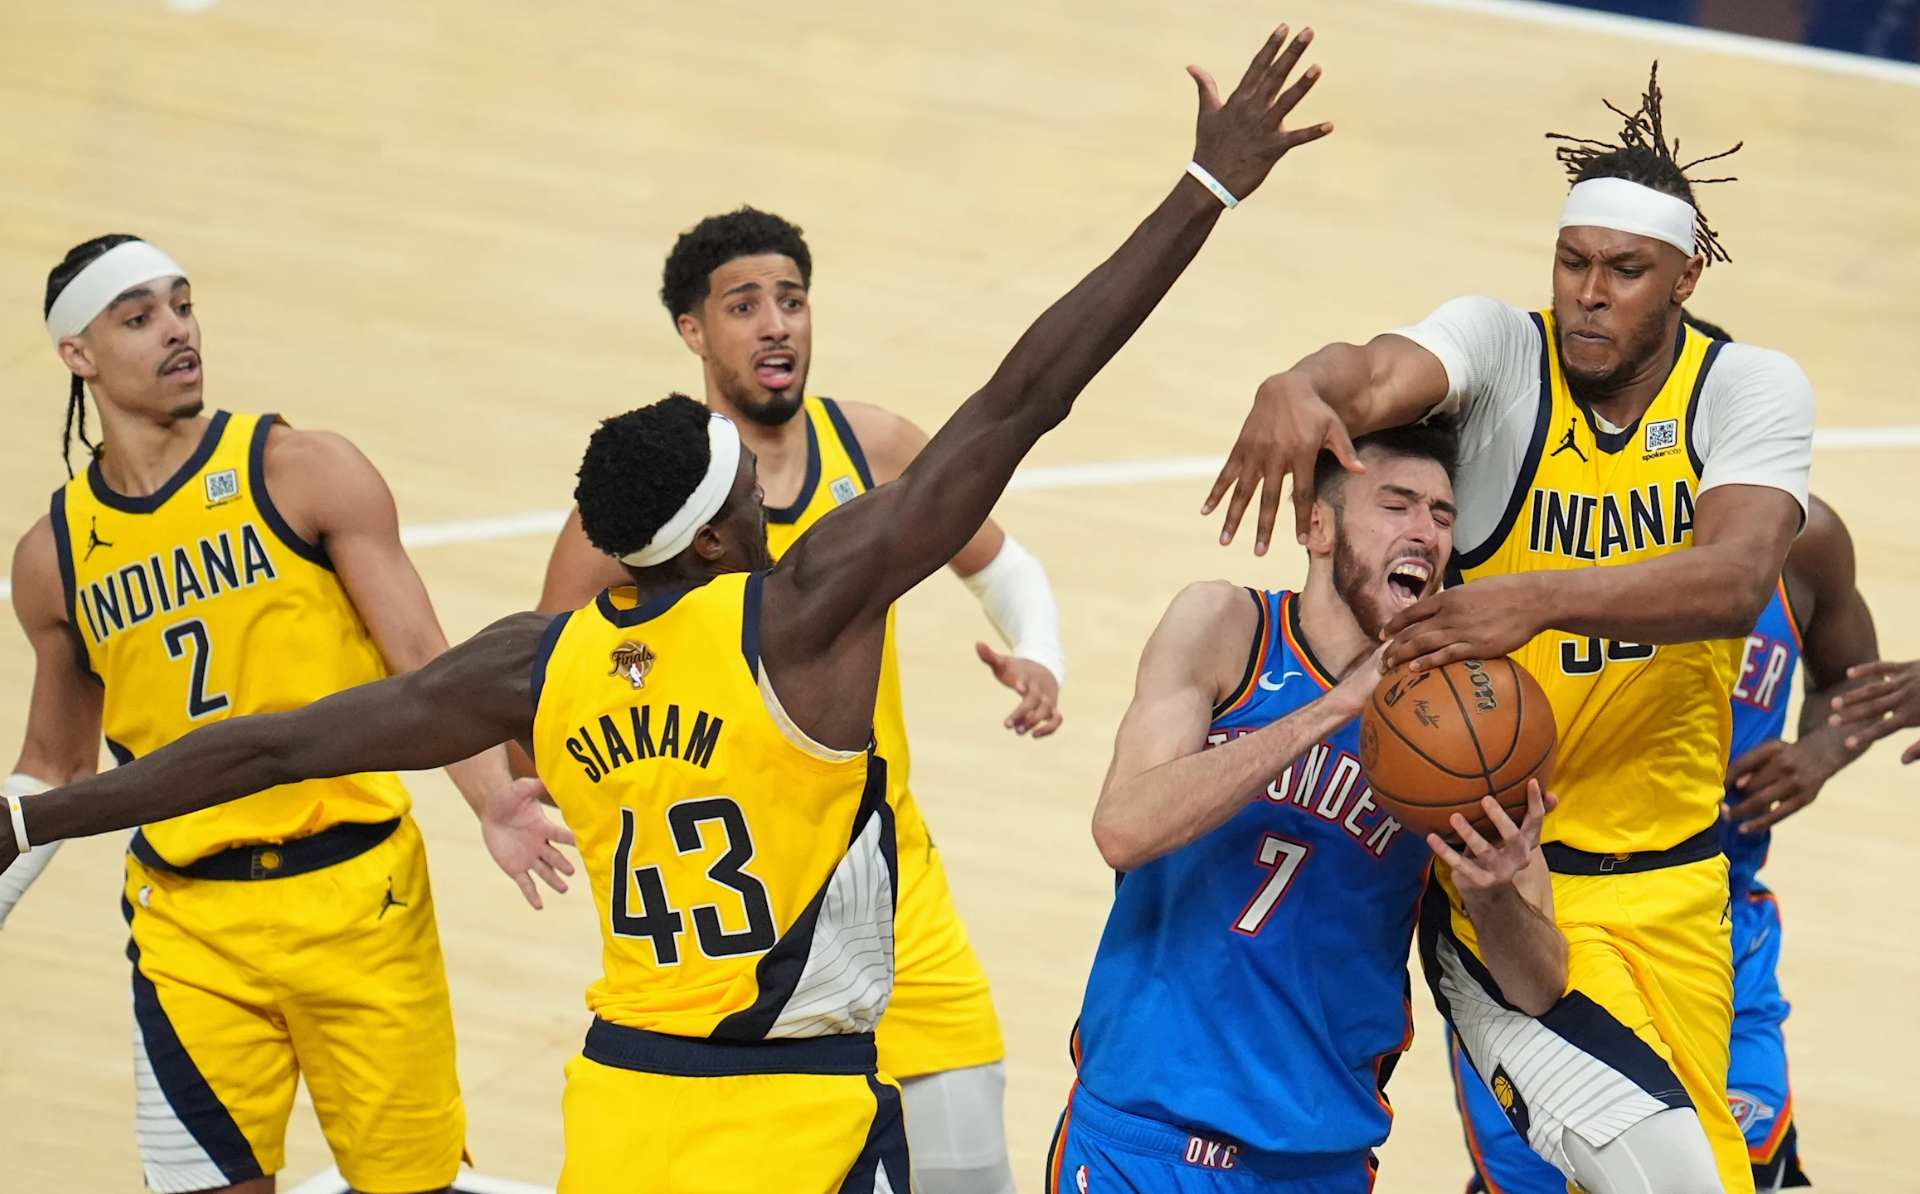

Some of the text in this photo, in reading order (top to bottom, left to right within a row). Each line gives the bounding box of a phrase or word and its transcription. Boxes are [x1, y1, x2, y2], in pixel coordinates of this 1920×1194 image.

[1529, 479, 1696, 562] INDANA
[79, 523, 277, 644] INDIANA
[164, 618, 229, 720] 2
[608, 645, 655, 674] Finals
[566, 704, 723, 784] SIAKAM
[611, 796, 779, 968] 43
[1231, 833, 1312, 937] 7
[1185, 1136, 1238, 1169] OKC
